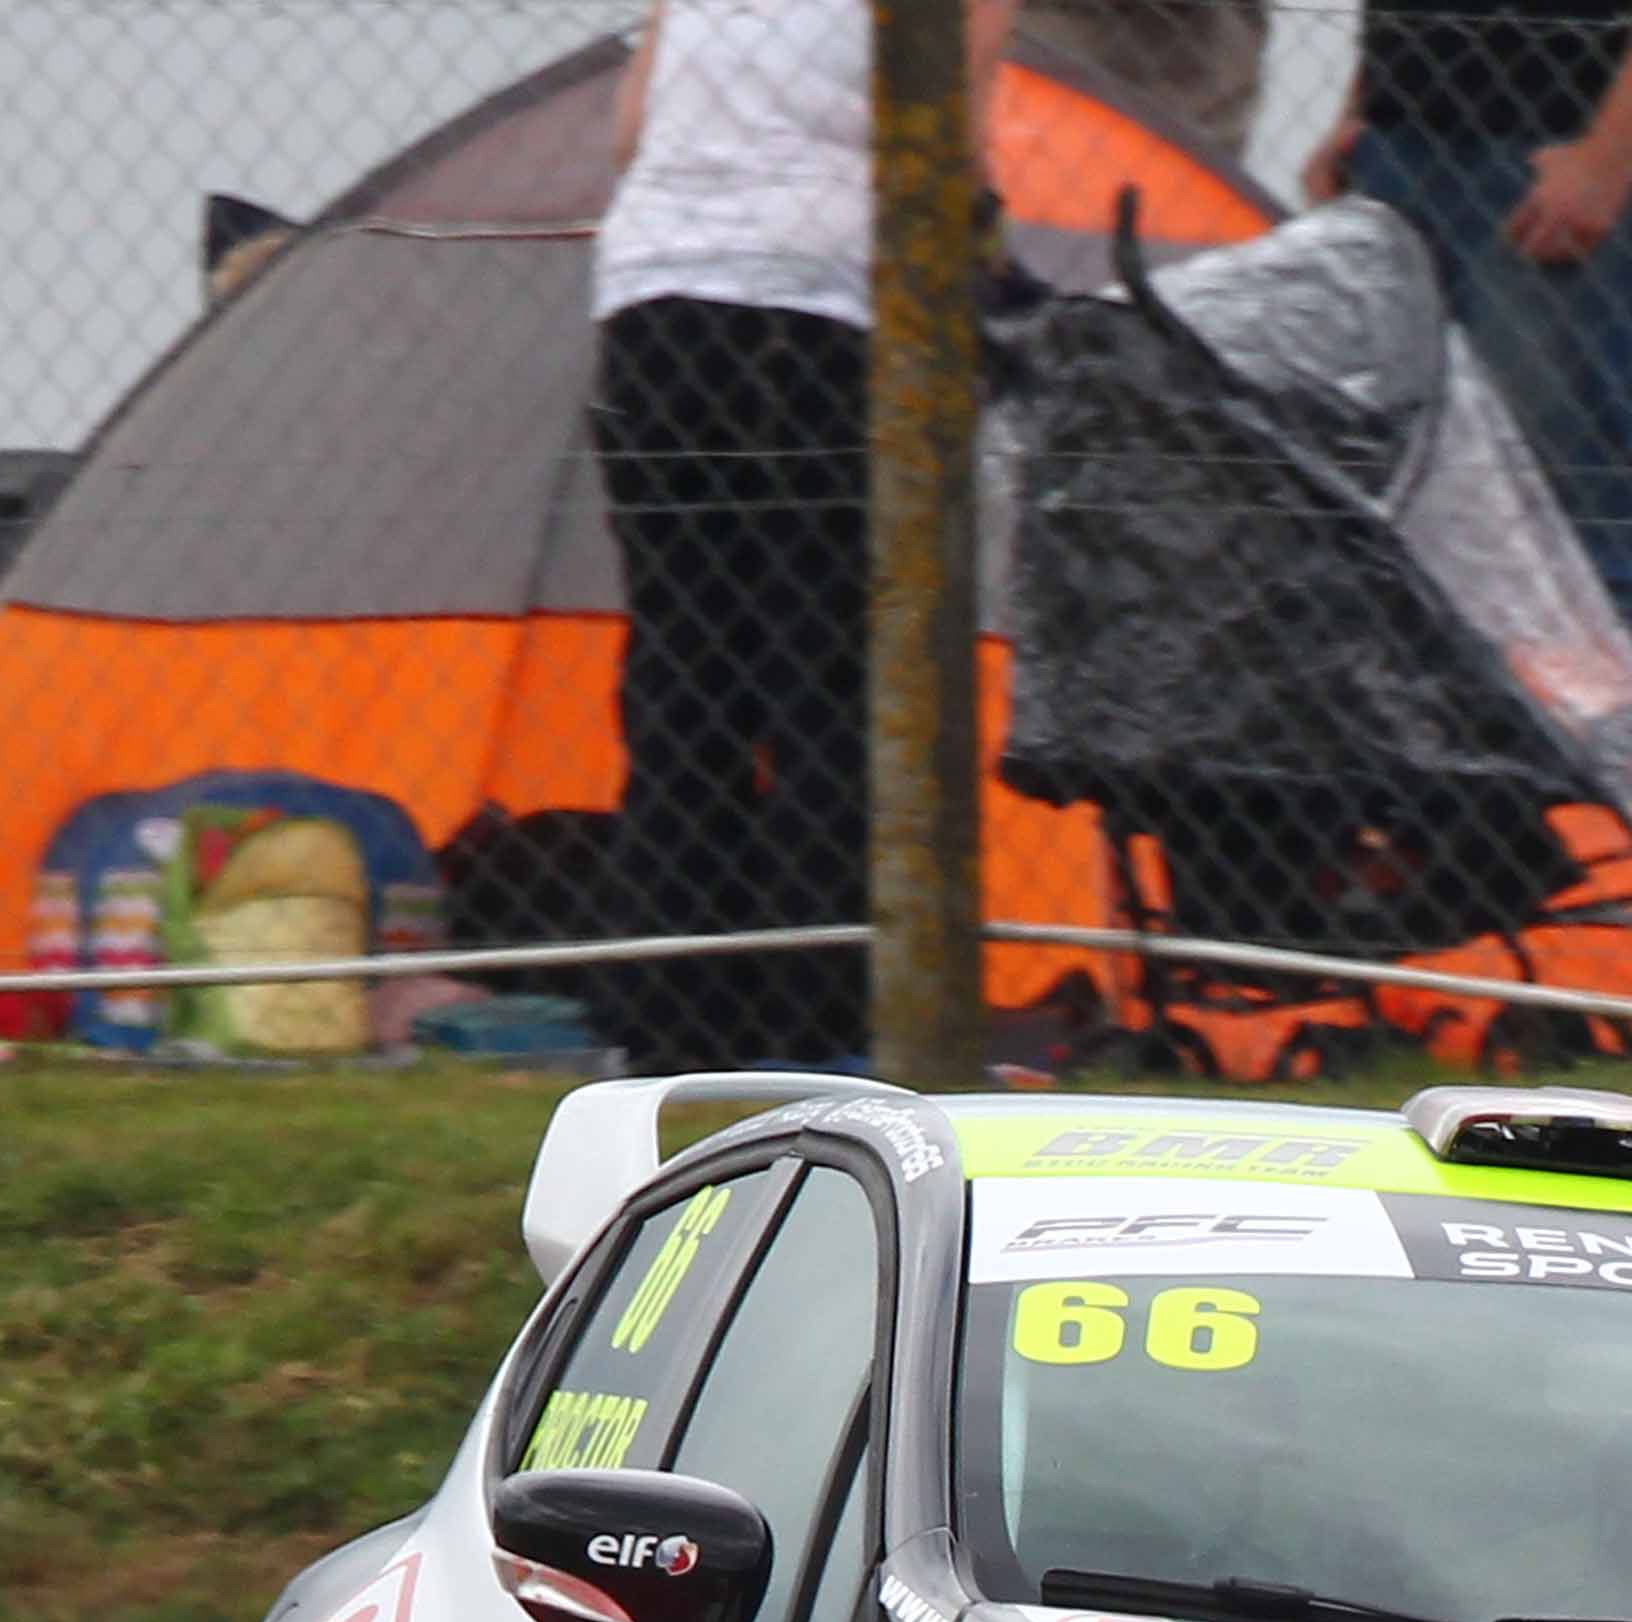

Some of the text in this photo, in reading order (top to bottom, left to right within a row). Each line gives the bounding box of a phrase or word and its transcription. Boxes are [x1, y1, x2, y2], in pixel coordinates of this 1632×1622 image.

[1015, 1213, 1330, 1240] PFC
[1011, 1281, 1262, 1371] 66
[587, 1534, 658, 1569] elf
